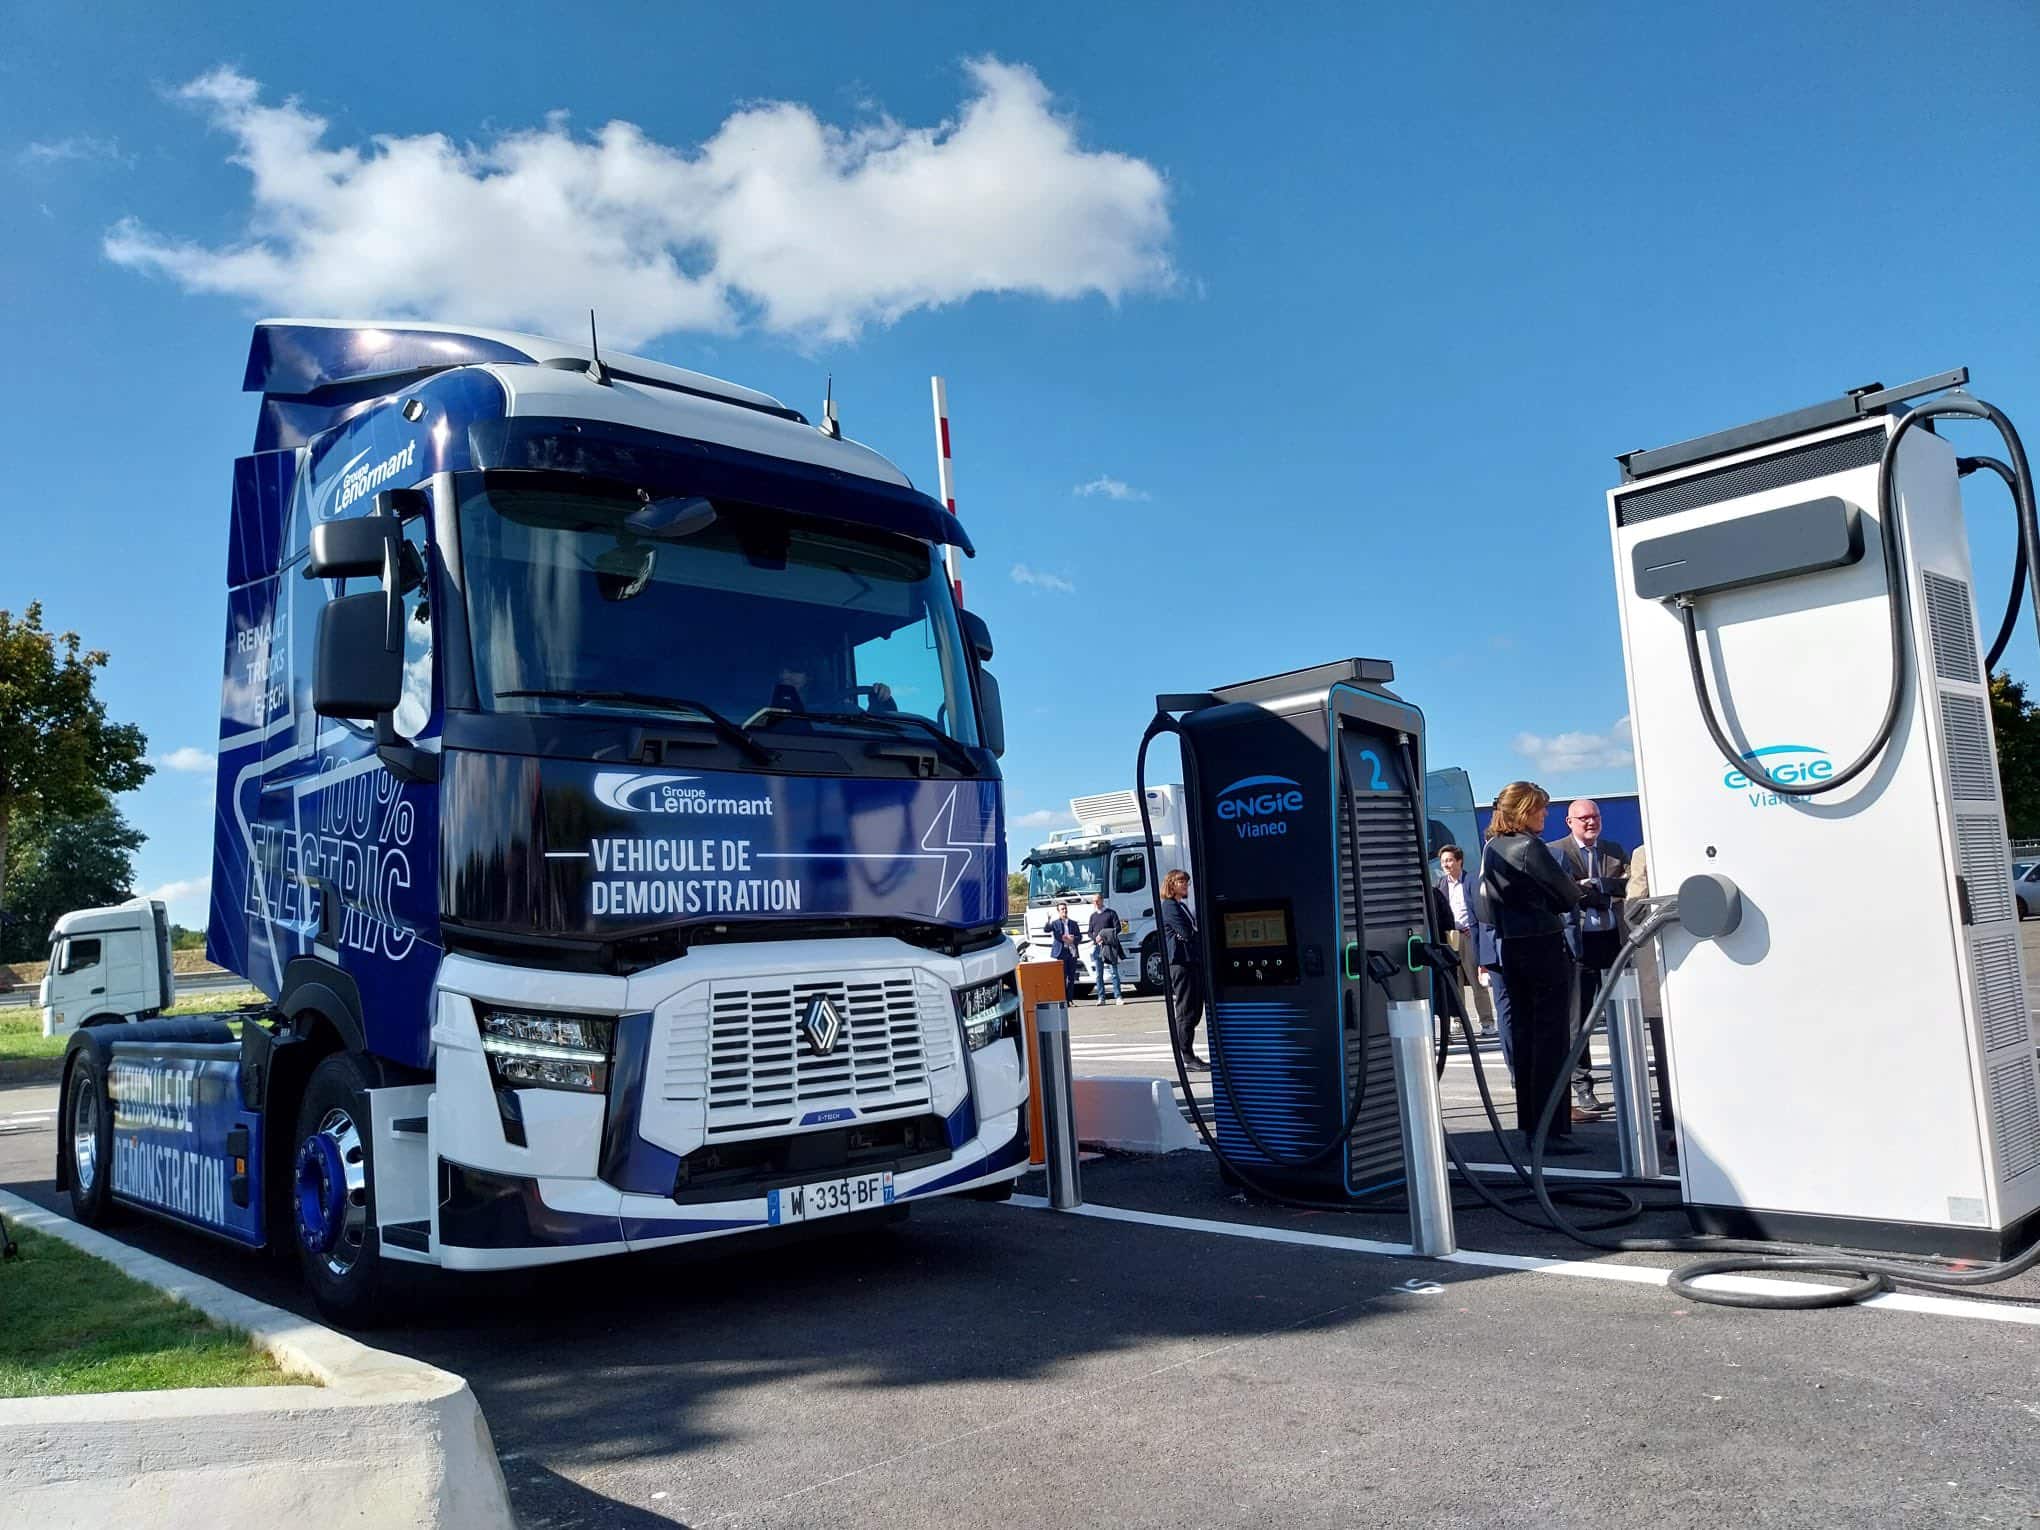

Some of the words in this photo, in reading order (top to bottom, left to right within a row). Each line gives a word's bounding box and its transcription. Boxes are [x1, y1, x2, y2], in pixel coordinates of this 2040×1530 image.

[334, 439, 416, 515] Lenormant
[1359, 749, 1390, 791] 2
[320, 755, 415, 846] 100%
[649, 791, 773, 817] Lenormant
[661, 785, 706, 801] Groupe
[1236, 820, 1287, 839] Vianeo
[592, 838, 716, 873] VEHICULE
[721, 838, 751, 872] DE
[244, 824, 416, 961] ELECTRIC
[591, 878, 802, 916] DEMONSTRATION
[114, 1135, 225, 1228] DEMONSTRATION
